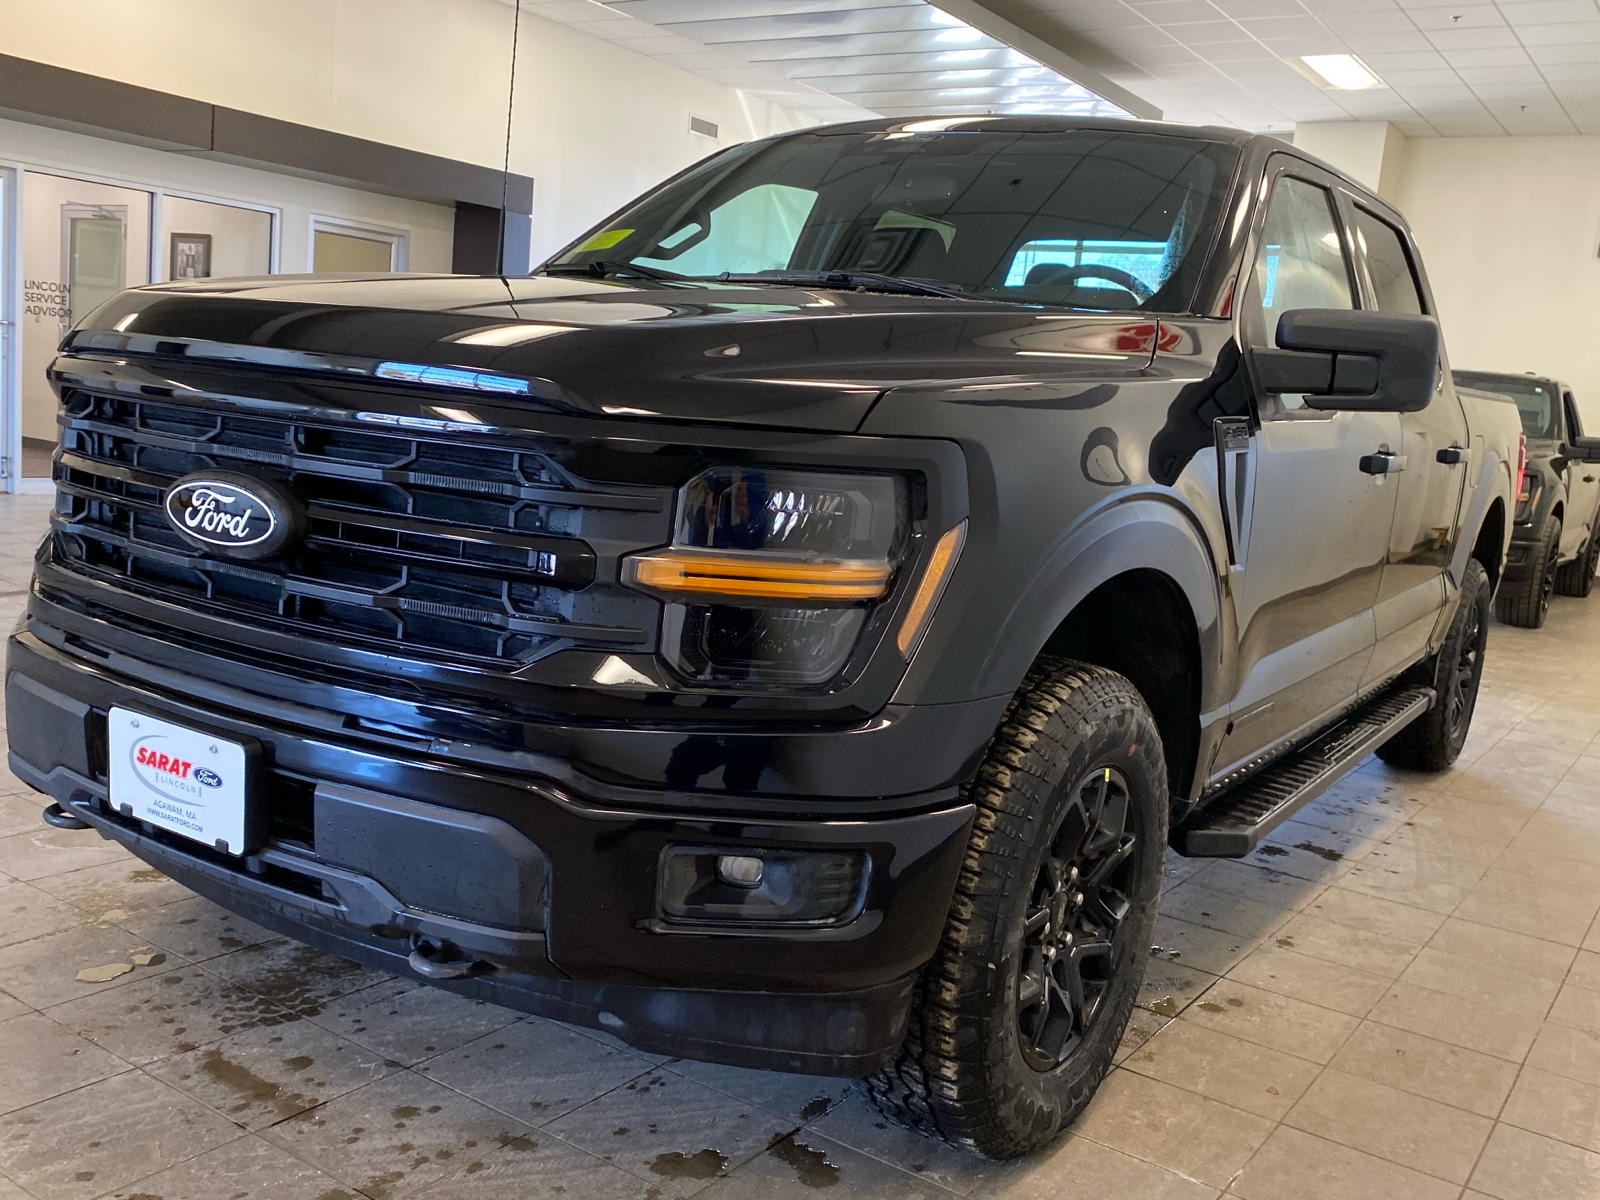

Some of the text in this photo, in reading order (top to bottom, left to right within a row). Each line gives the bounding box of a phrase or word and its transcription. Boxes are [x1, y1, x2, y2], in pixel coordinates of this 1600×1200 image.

[24, 279, 71, 294] LINCOLN
[24, 291, 67, 306] SERVICE
[24, 305, 73, 319] ADVISOR
[184, 488, 252, 538] Ford
[136, 746, 192, 779] SARAT
[160, 775, 196, 794] LINCOLN
[196, 769, 219, 787] Ford
[146, 806, 204, 833] WWW.SARATFORD.COM
[153, 799, 197, 821] AGAWAM, MA
